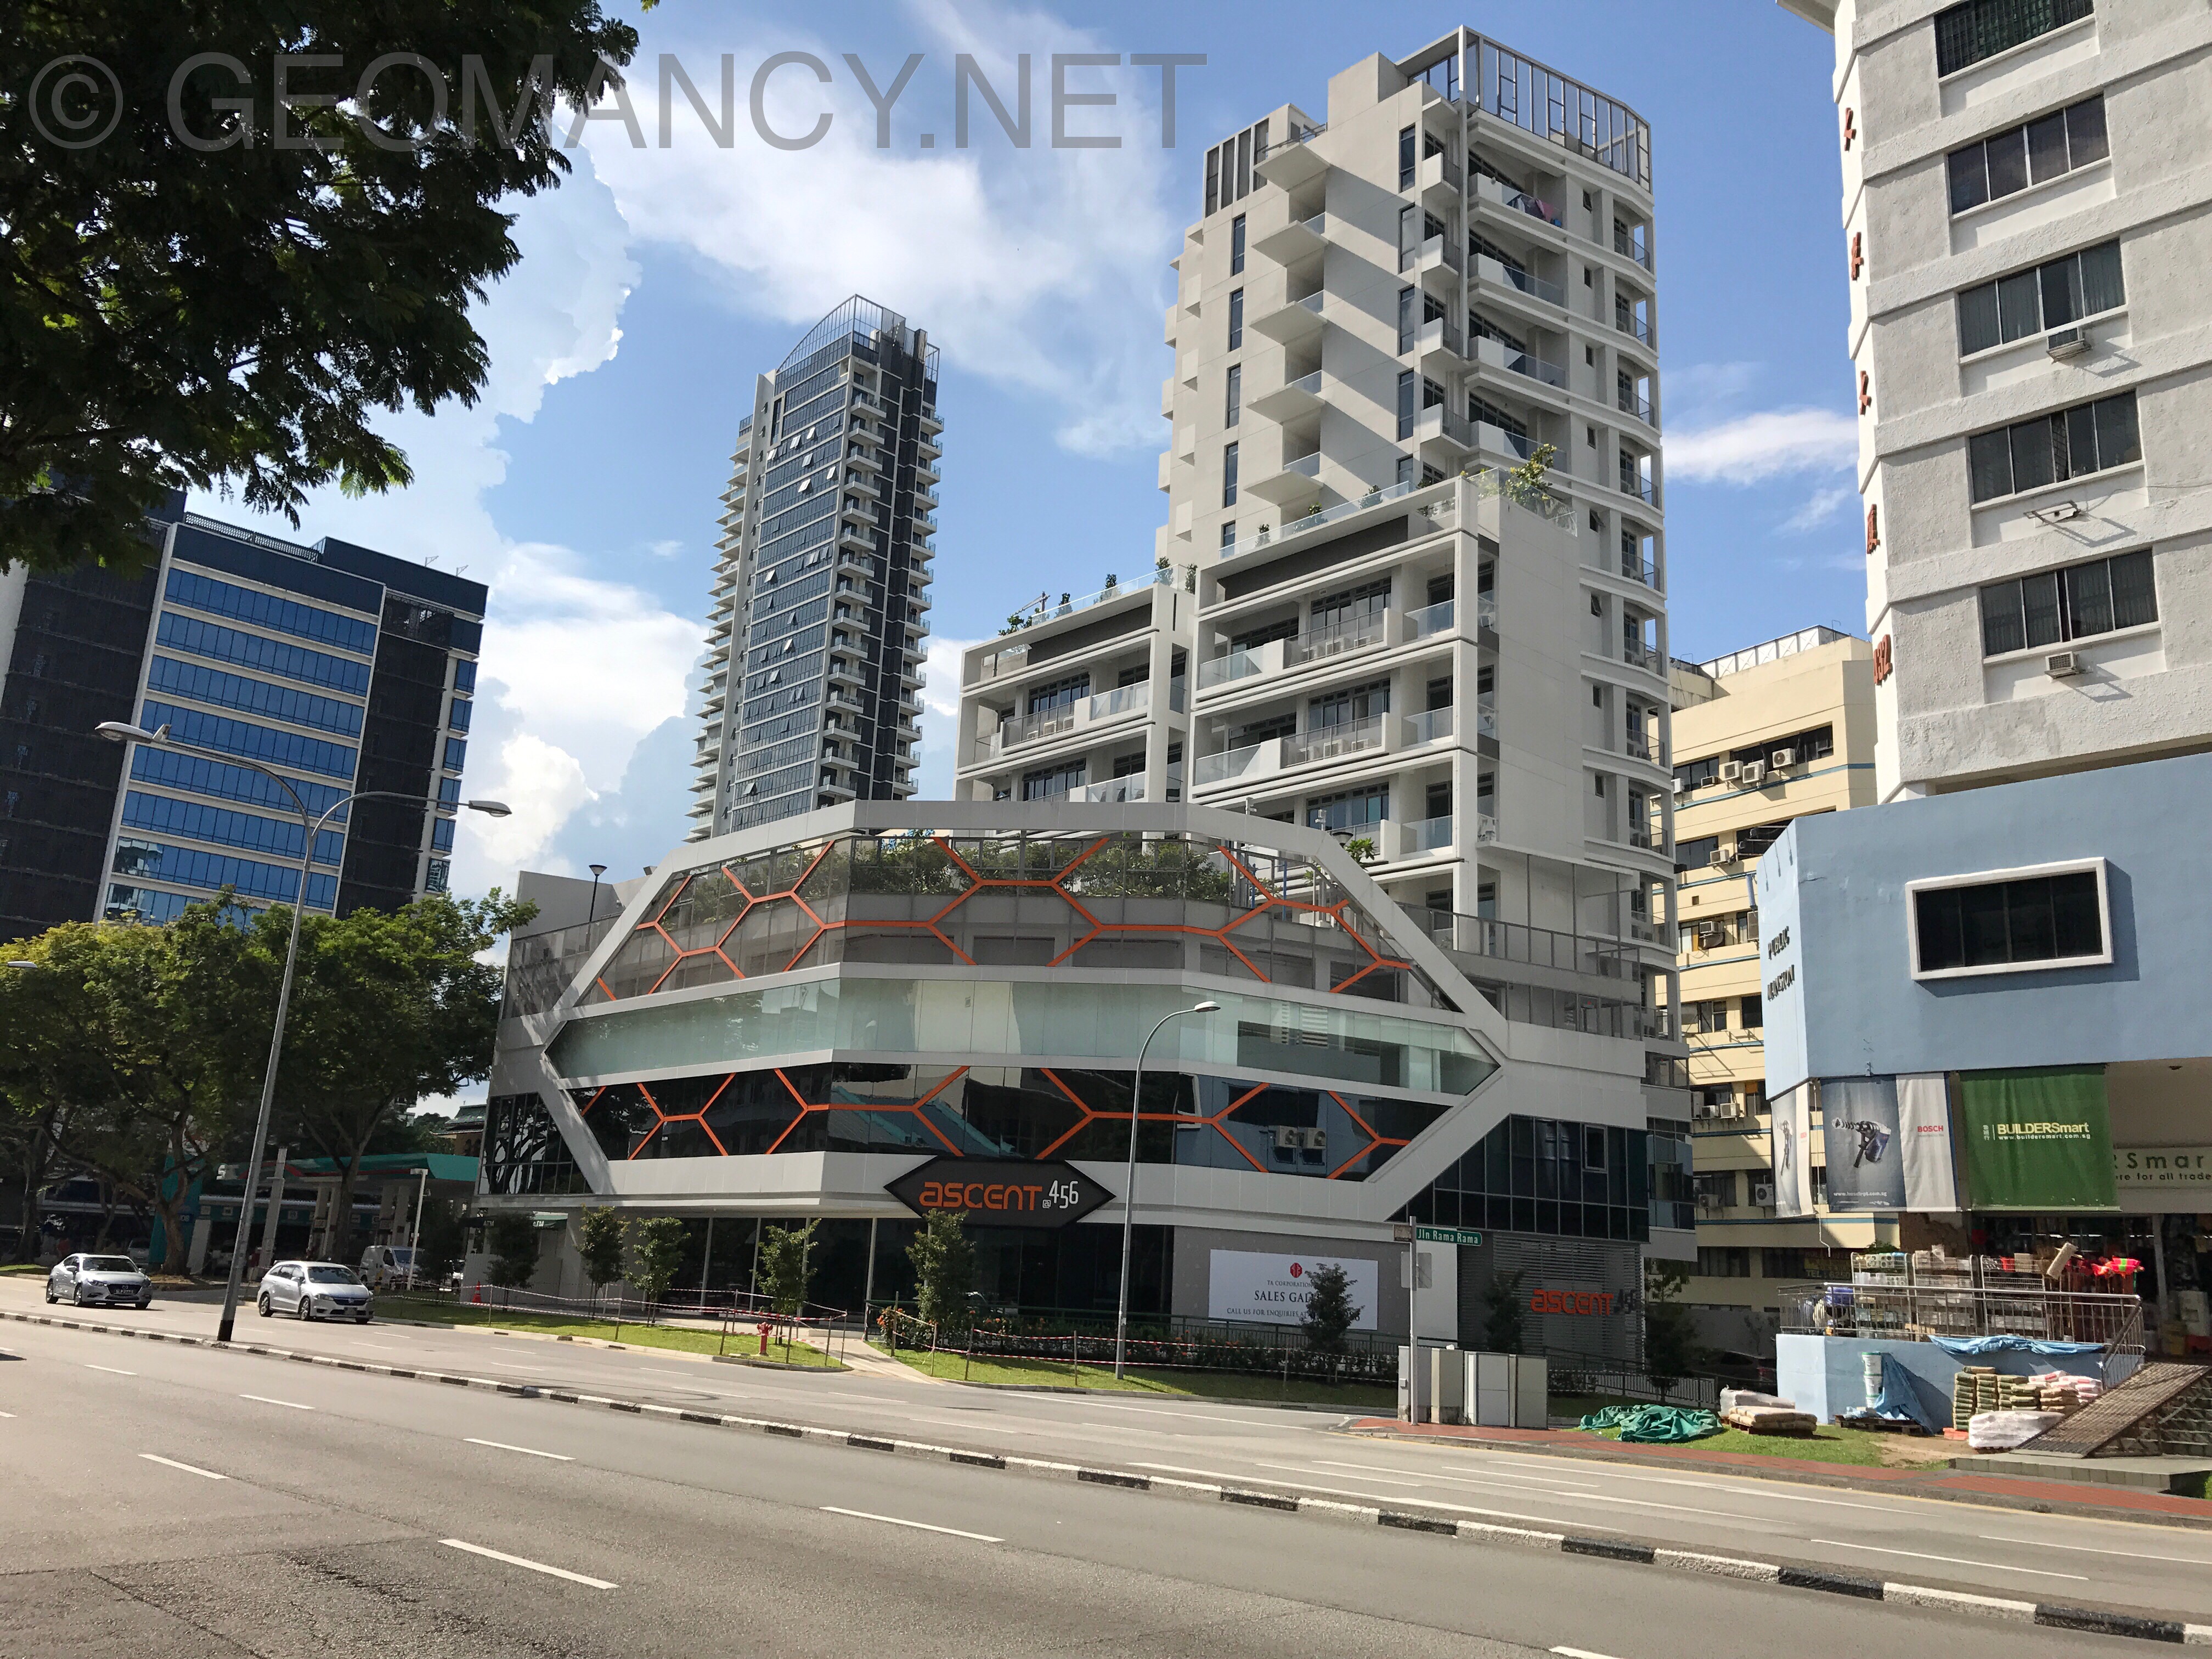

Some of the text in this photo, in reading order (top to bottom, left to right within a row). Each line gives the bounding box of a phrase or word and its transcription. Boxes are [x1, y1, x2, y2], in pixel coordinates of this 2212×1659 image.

[1767, 926, 1790, 960] PUBLIC
[1767, 964, 1795, 1002] MANSION
[1997, 1122, 2090, 1135] BUILDERSmart
[2113, 1152, 2204, 1169] Smar
[1418, 1228, 1479, 1244] Jln Rama Rama
[1254, 1290, 1285, 1302] SALES
